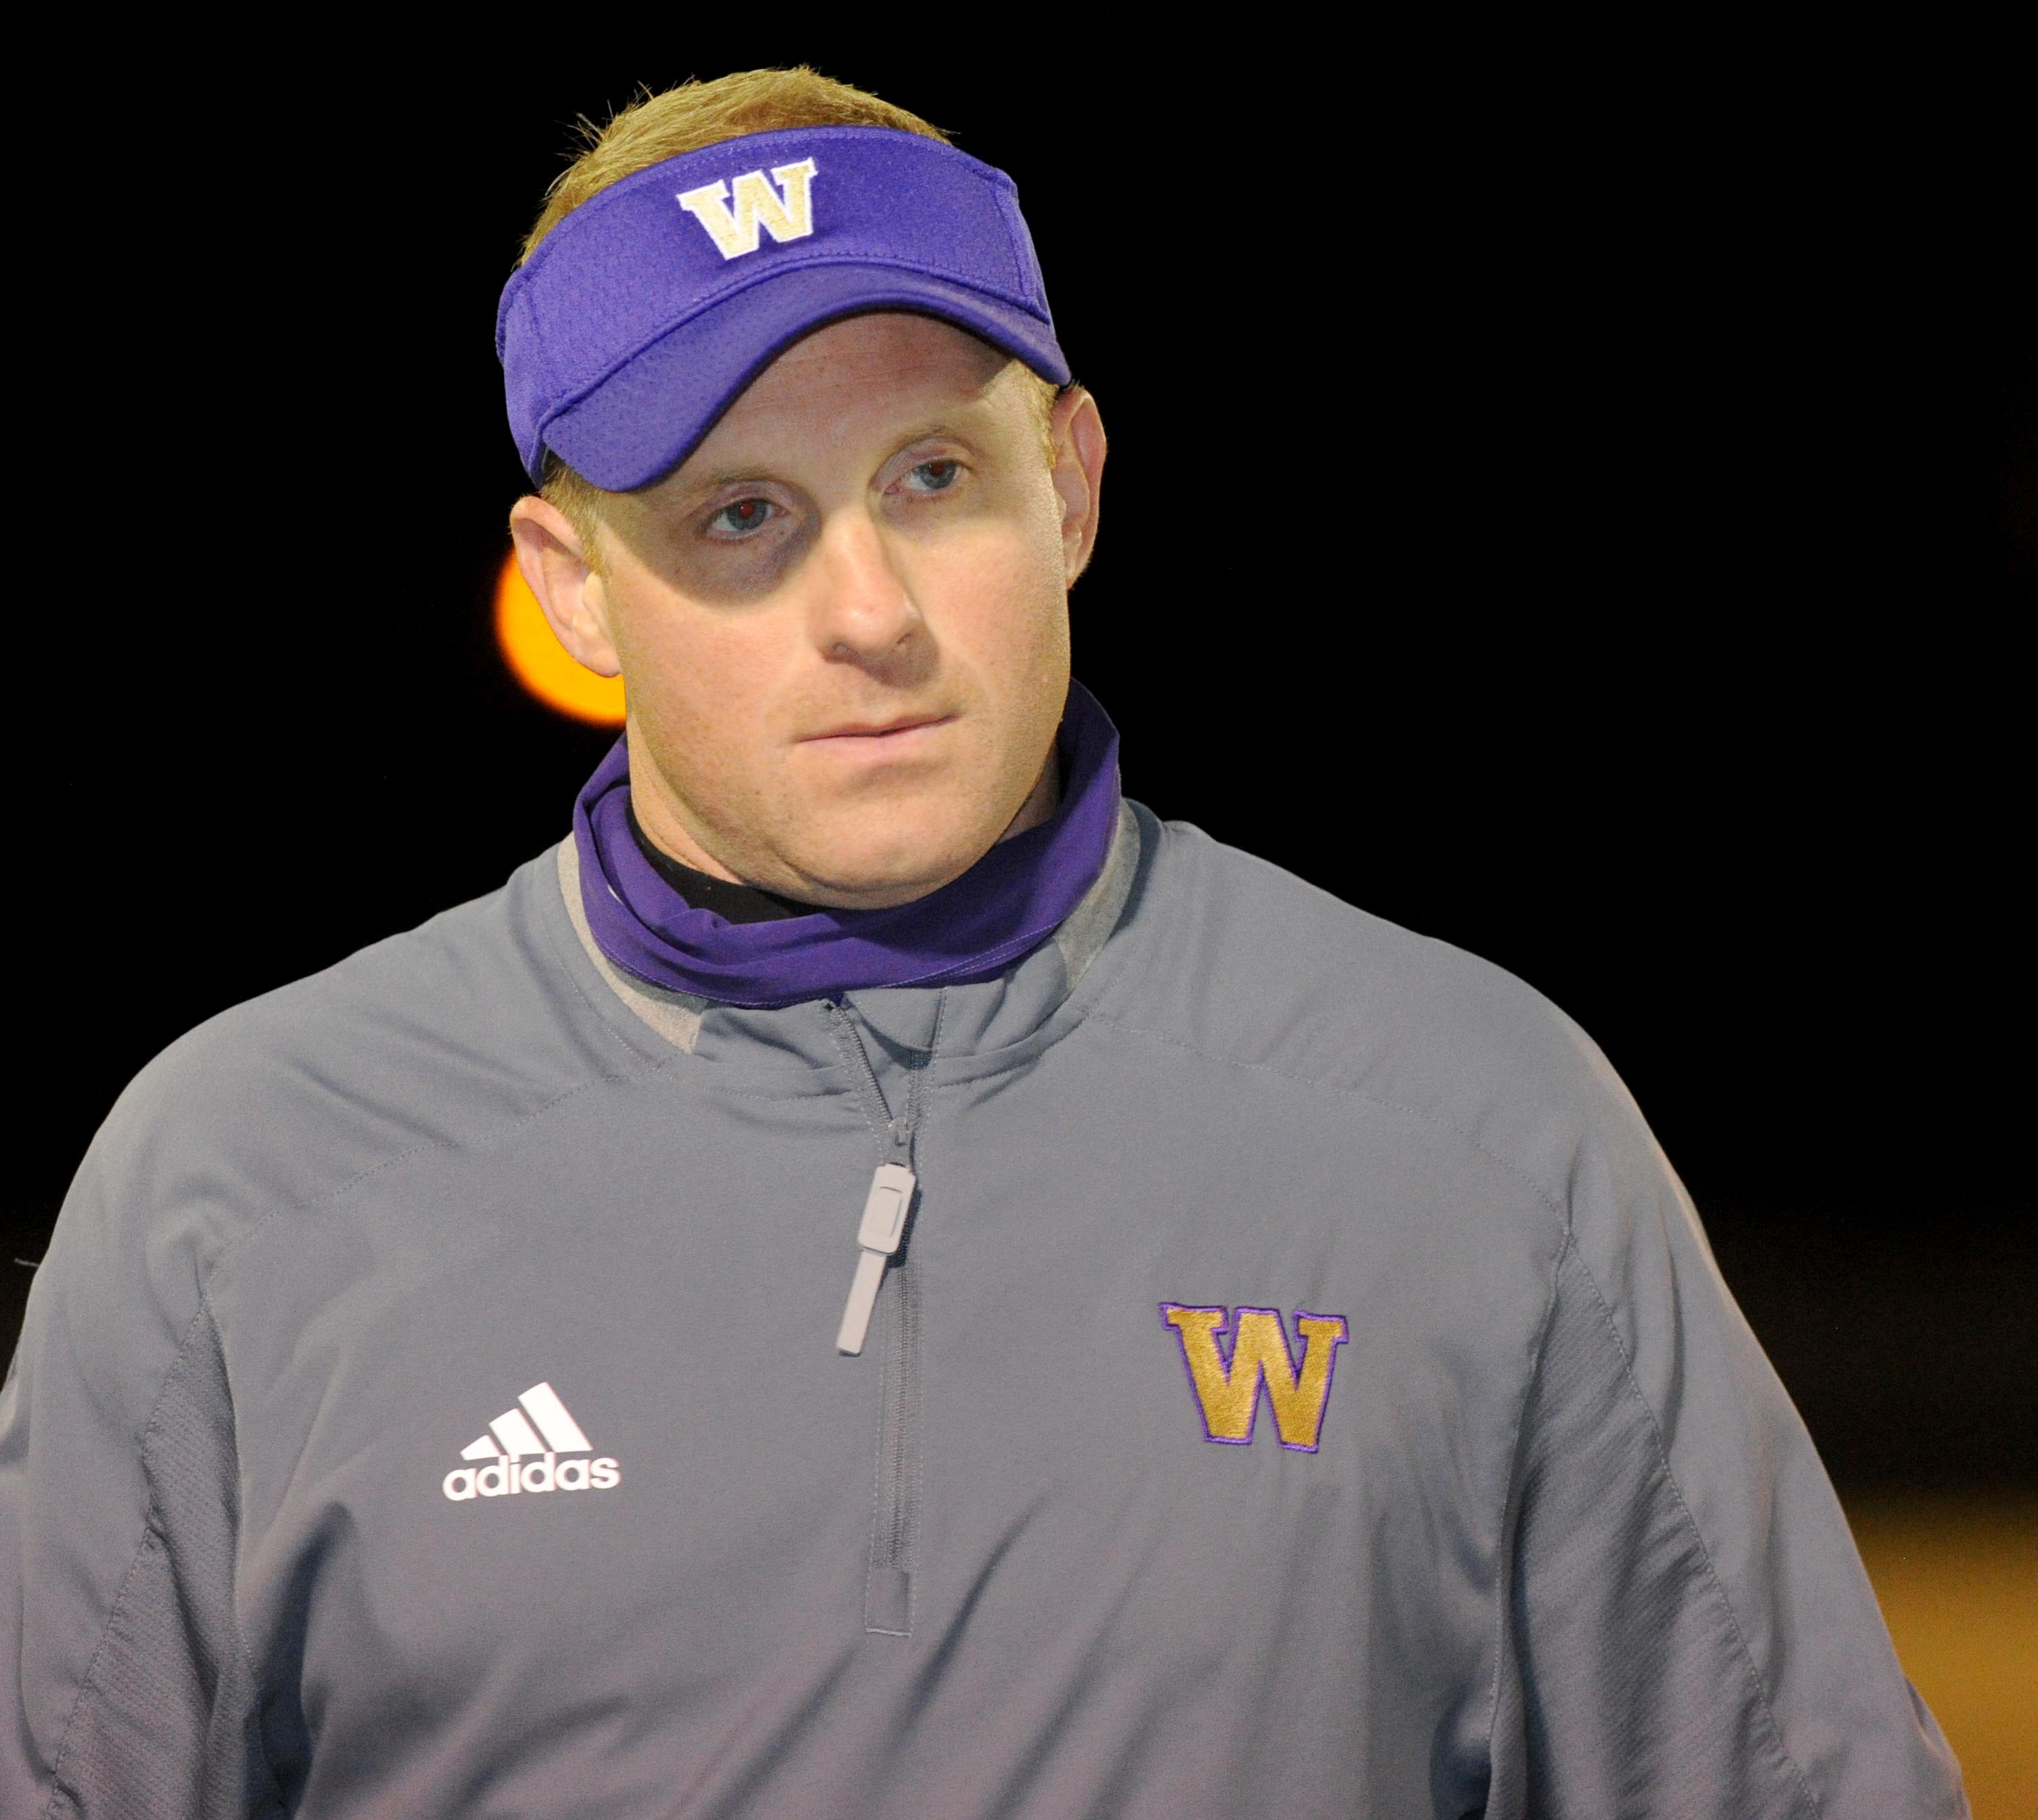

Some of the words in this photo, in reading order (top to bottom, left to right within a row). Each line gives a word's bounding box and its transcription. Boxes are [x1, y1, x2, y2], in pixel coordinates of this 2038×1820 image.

[675, 156, 819, 261] W
[1158, 1302, 1349, 1454] W
[442, 1452, 622, 1501] adidas
